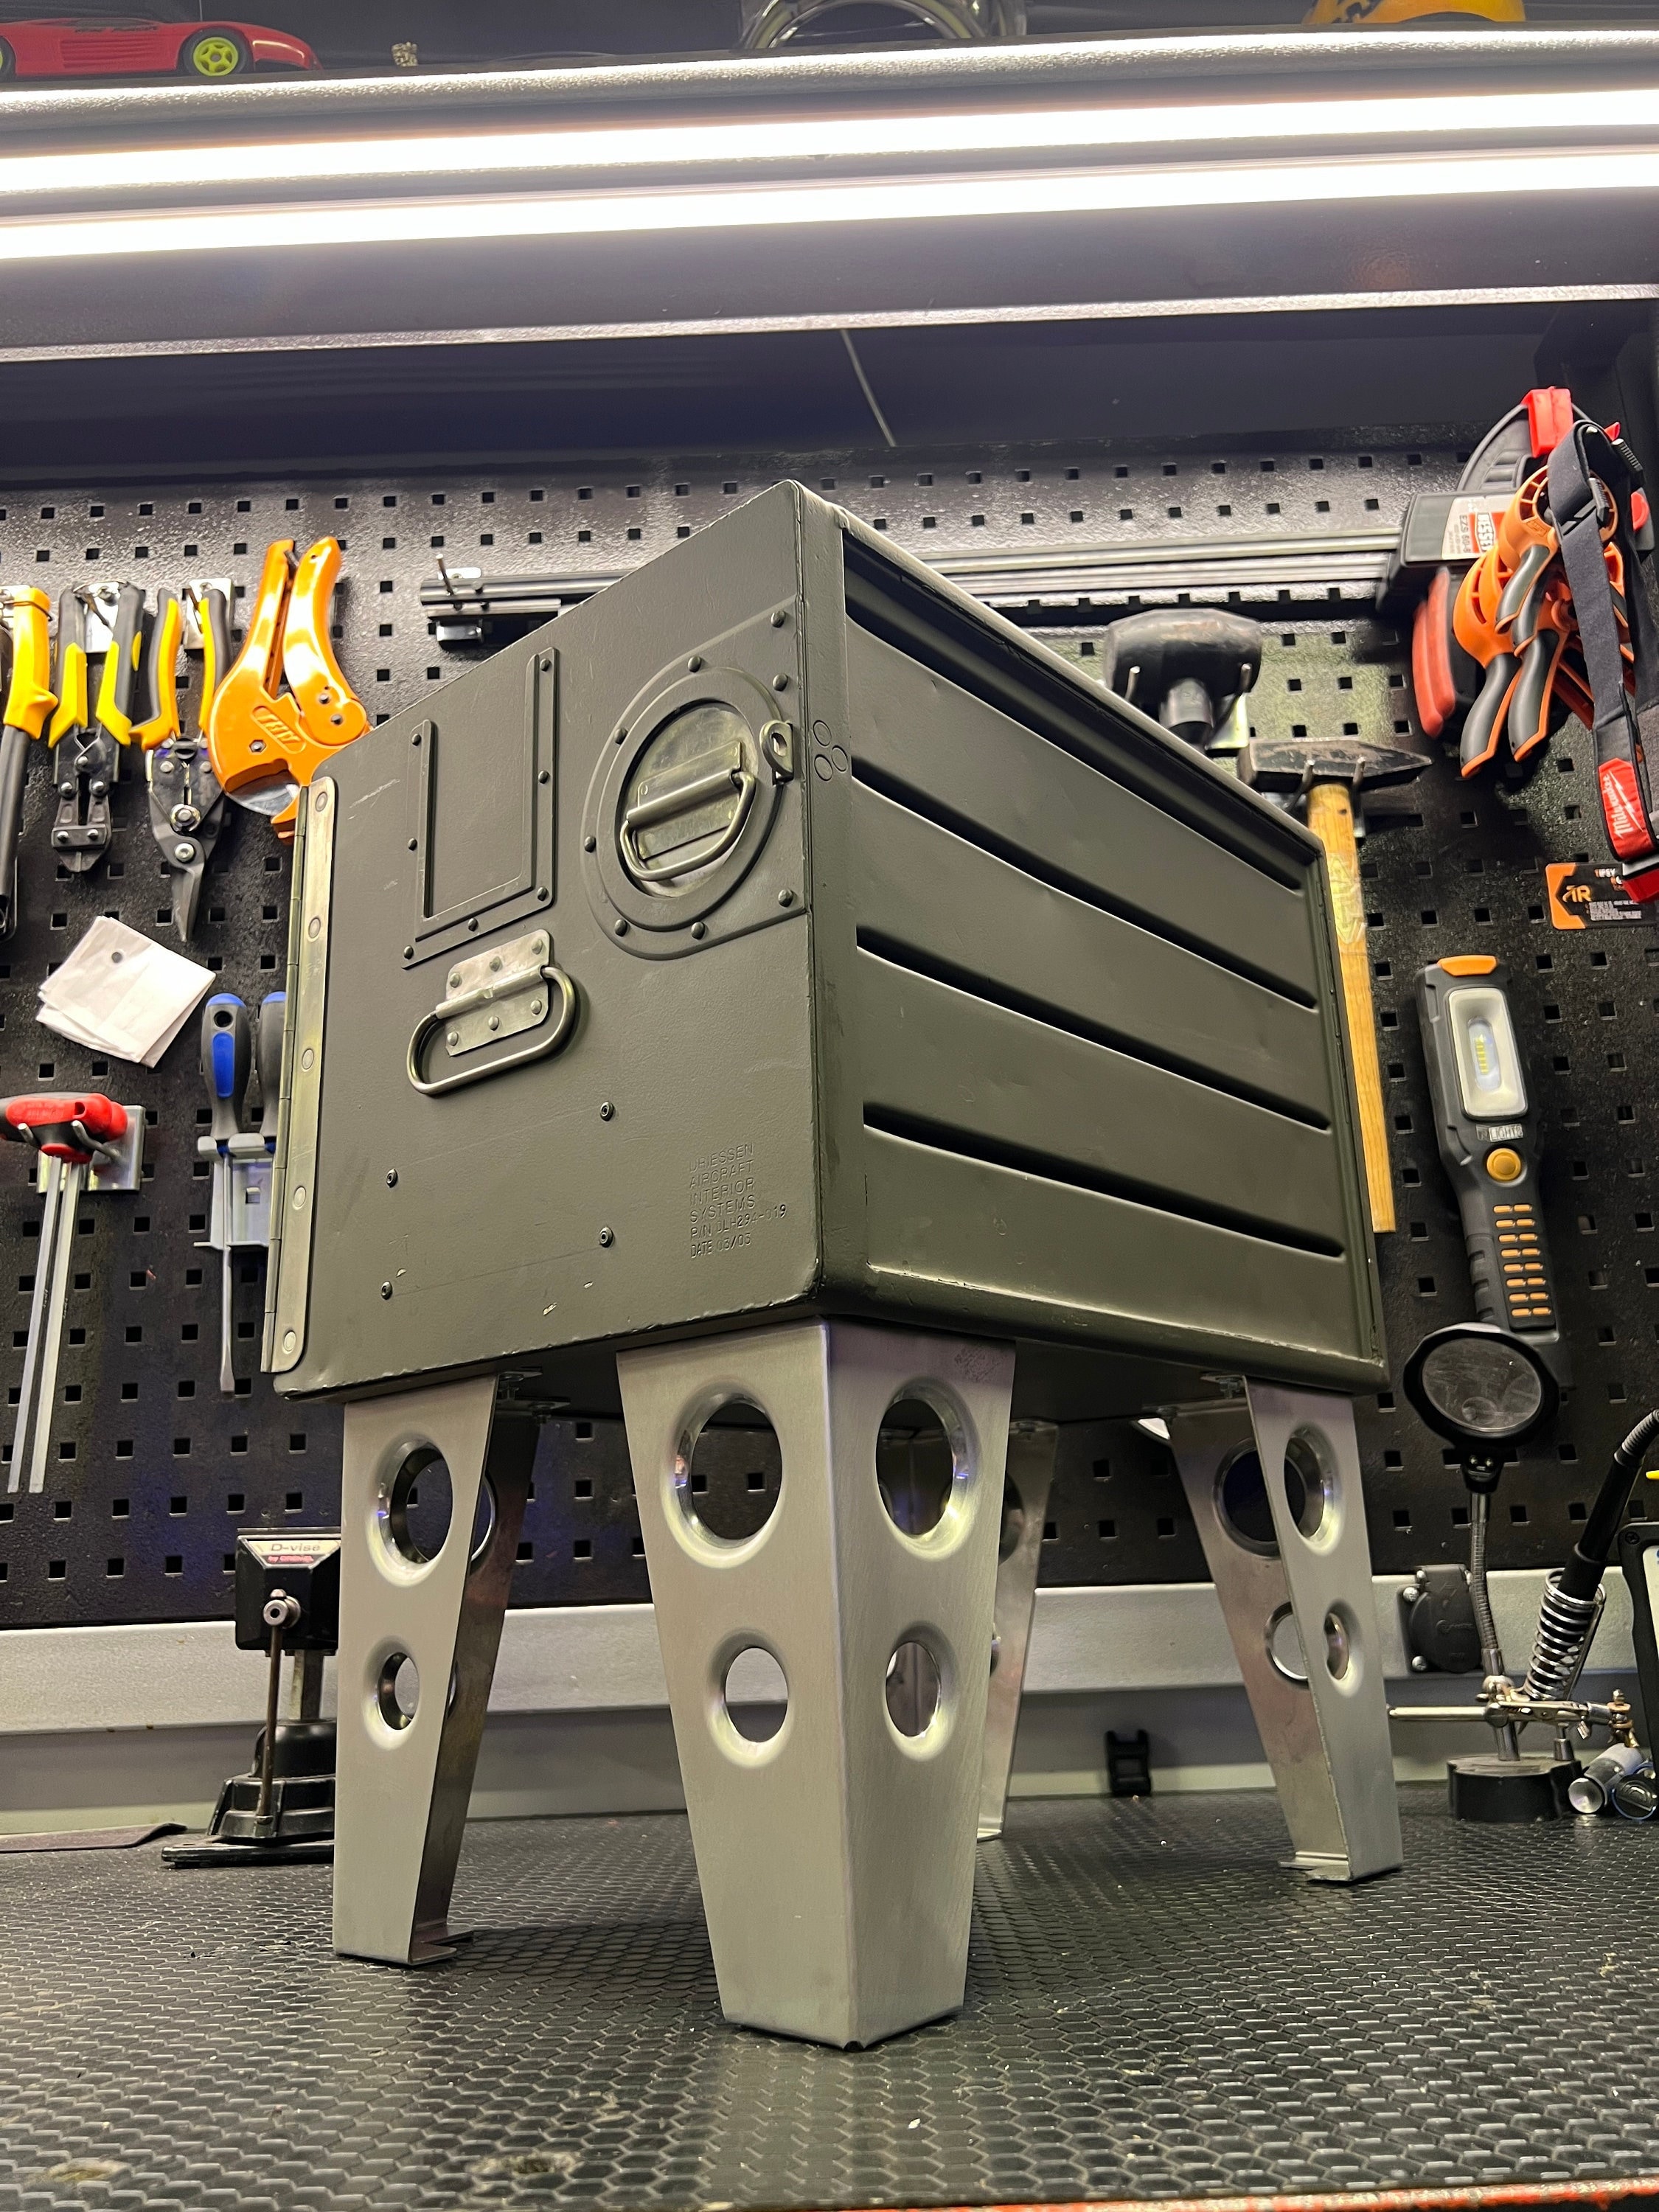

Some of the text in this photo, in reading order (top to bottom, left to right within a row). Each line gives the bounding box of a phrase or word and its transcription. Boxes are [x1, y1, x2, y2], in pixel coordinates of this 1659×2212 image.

[1602, 773, 1635, 839] Milwaukee
[690, 1144, 754, 1174] DRIESSEN
[690, 1159, 755, 1190] AIRCRAFT
[690, 1178, 754, 1206] INTERIOR
[690, 1194, 756, 1224] SYSTEMS
[691, 1223, 712, 1240] P/N
[691, 1239, 714, 1259] DATE
[271, 1543, 321, 1551] D-vise
